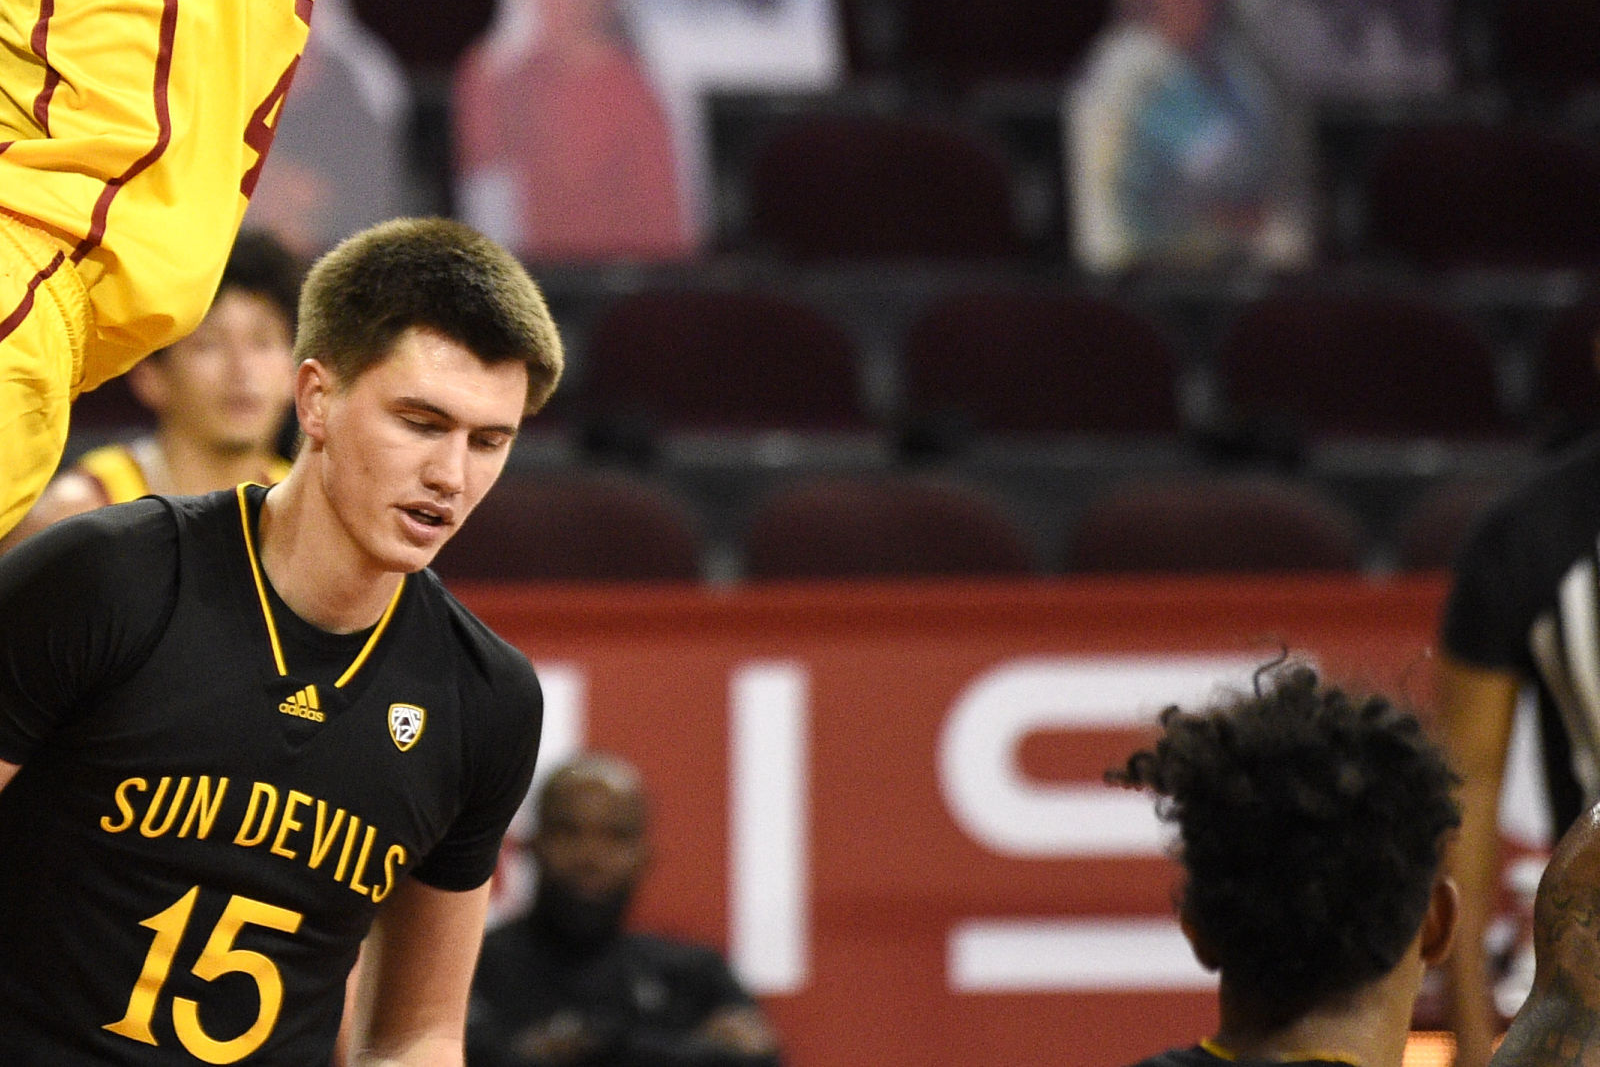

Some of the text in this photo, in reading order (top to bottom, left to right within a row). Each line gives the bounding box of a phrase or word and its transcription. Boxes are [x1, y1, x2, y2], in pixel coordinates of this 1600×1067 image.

[279, 702, 326, 723] adidas
[392, 707, 422, 734] PAC
[100, 775, 407, 904] SUN DEVILS
[101, 884, 304, 1065] 15
